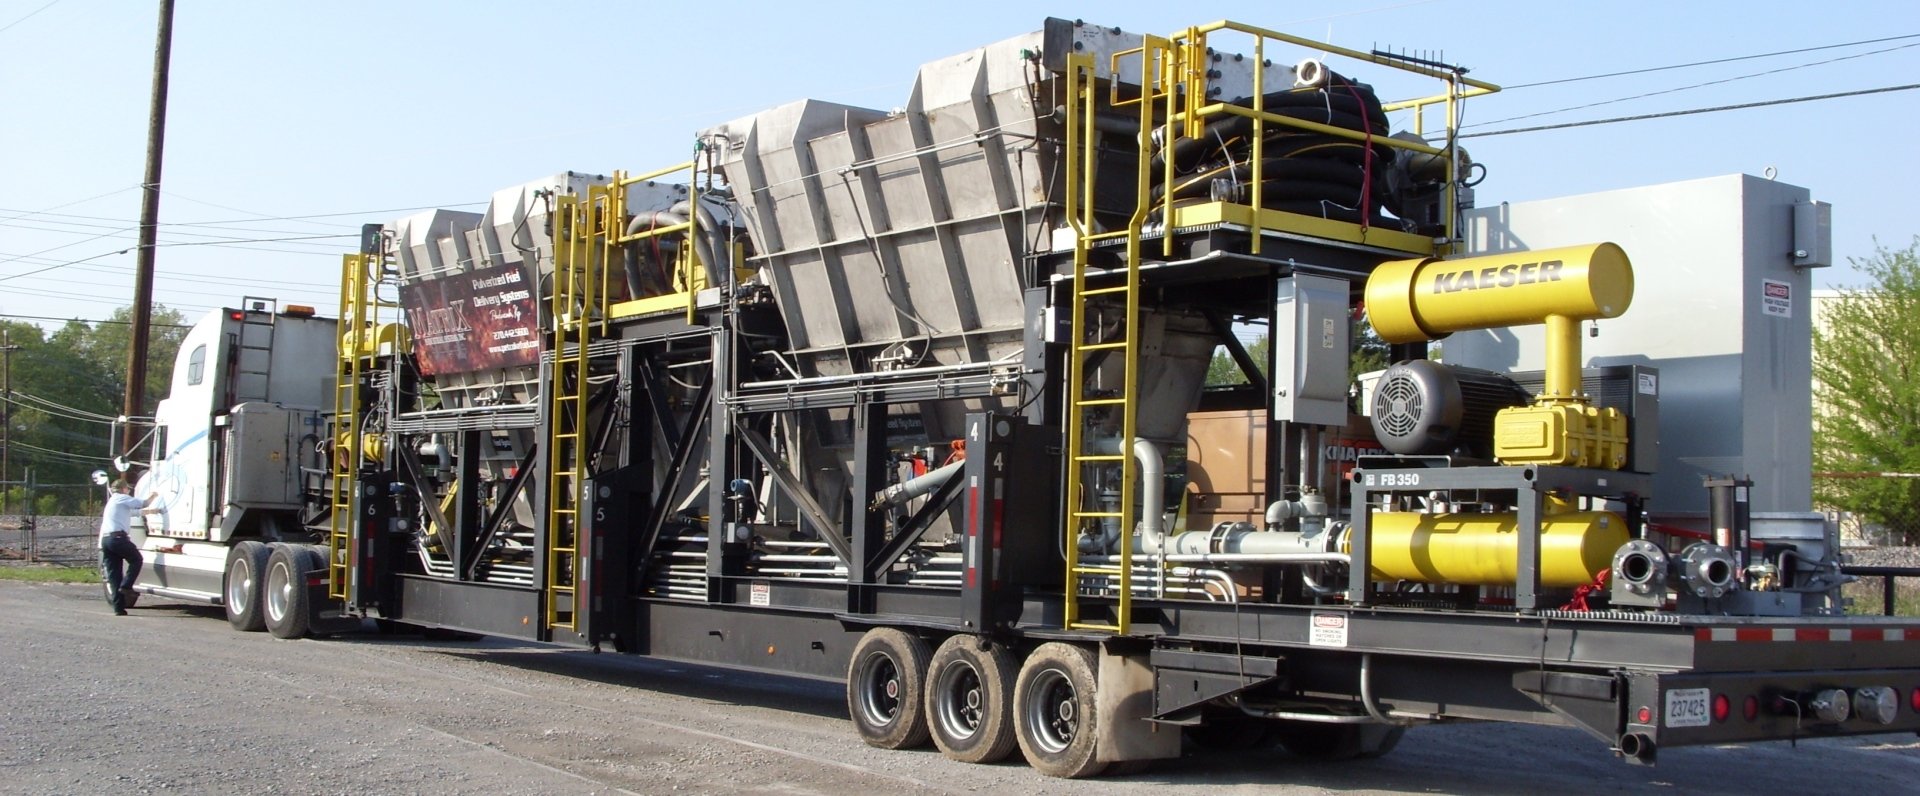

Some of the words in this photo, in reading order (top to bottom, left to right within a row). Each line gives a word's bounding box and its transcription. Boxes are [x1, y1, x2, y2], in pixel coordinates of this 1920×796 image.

[472, 273, 506, 289] Pulverized
[505, 270, 521, 284] Fuel
[1433, 260, 1563, 294] KAESER
[473, 295, 500, 307] Delivery
[499, 290, 529, 304] Systems
[970, 421, 979, 441] 4
[993, 452, 1003, 471] 4
[583, 485, 589, 500] 5
[367, 503, 376, 515] 6
[596, 507, 605, 521] 5
[1314, 616, 1344, 626] DANGER
[1671, 699, 1706, 718] 237425
